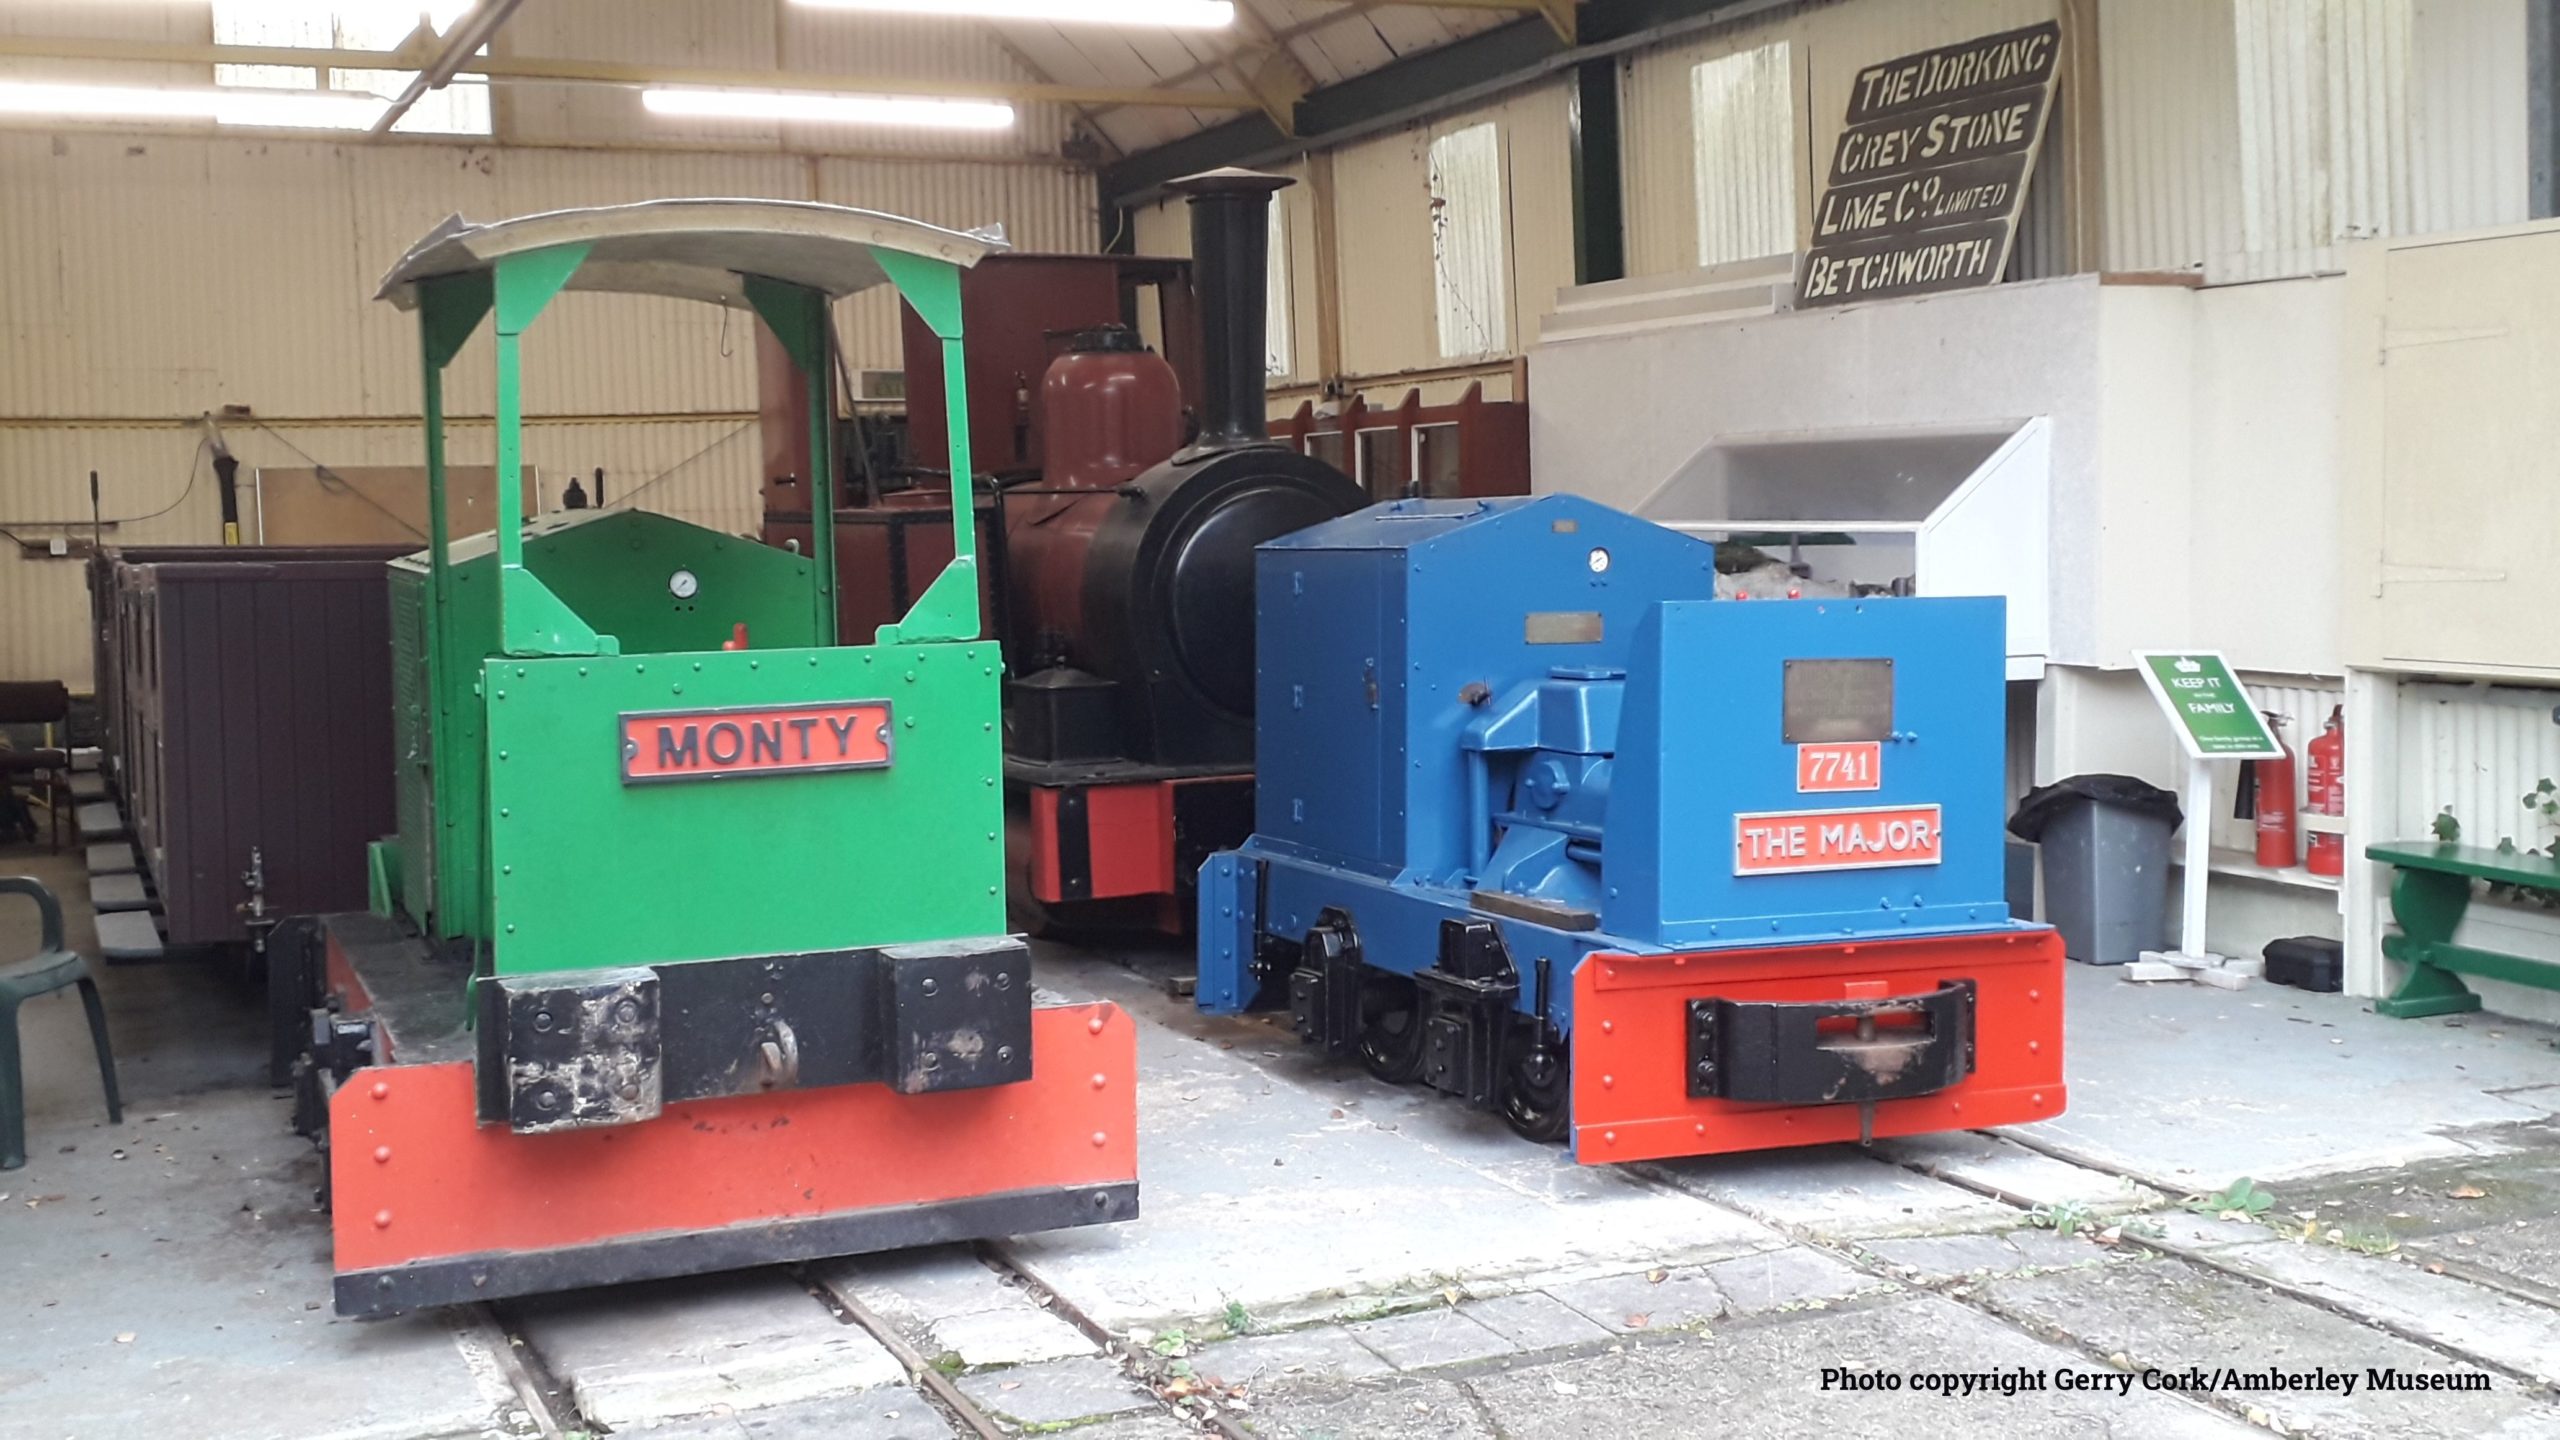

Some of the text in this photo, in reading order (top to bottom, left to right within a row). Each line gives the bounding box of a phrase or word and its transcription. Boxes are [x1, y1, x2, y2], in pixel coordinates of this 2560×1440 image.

[1861, 34, 2051, 110] THE DORKING
[1920, 103, 2031, 158] STONE
[1821, 191, 1892, 236] LIME
[1934, 183, 2007, 217] LIMITED
[1804, 238, 1992, 298] BETCHWORTH
[2171, 677, 2221, 688] KEEP IT
[2187, 703, 2235, 713] FAMILY
[656, 715, 857, 768] MONTY
[1809, 752, 1868, 782] 7741
[1745, 819, 1931, 859] THE MAJOR
